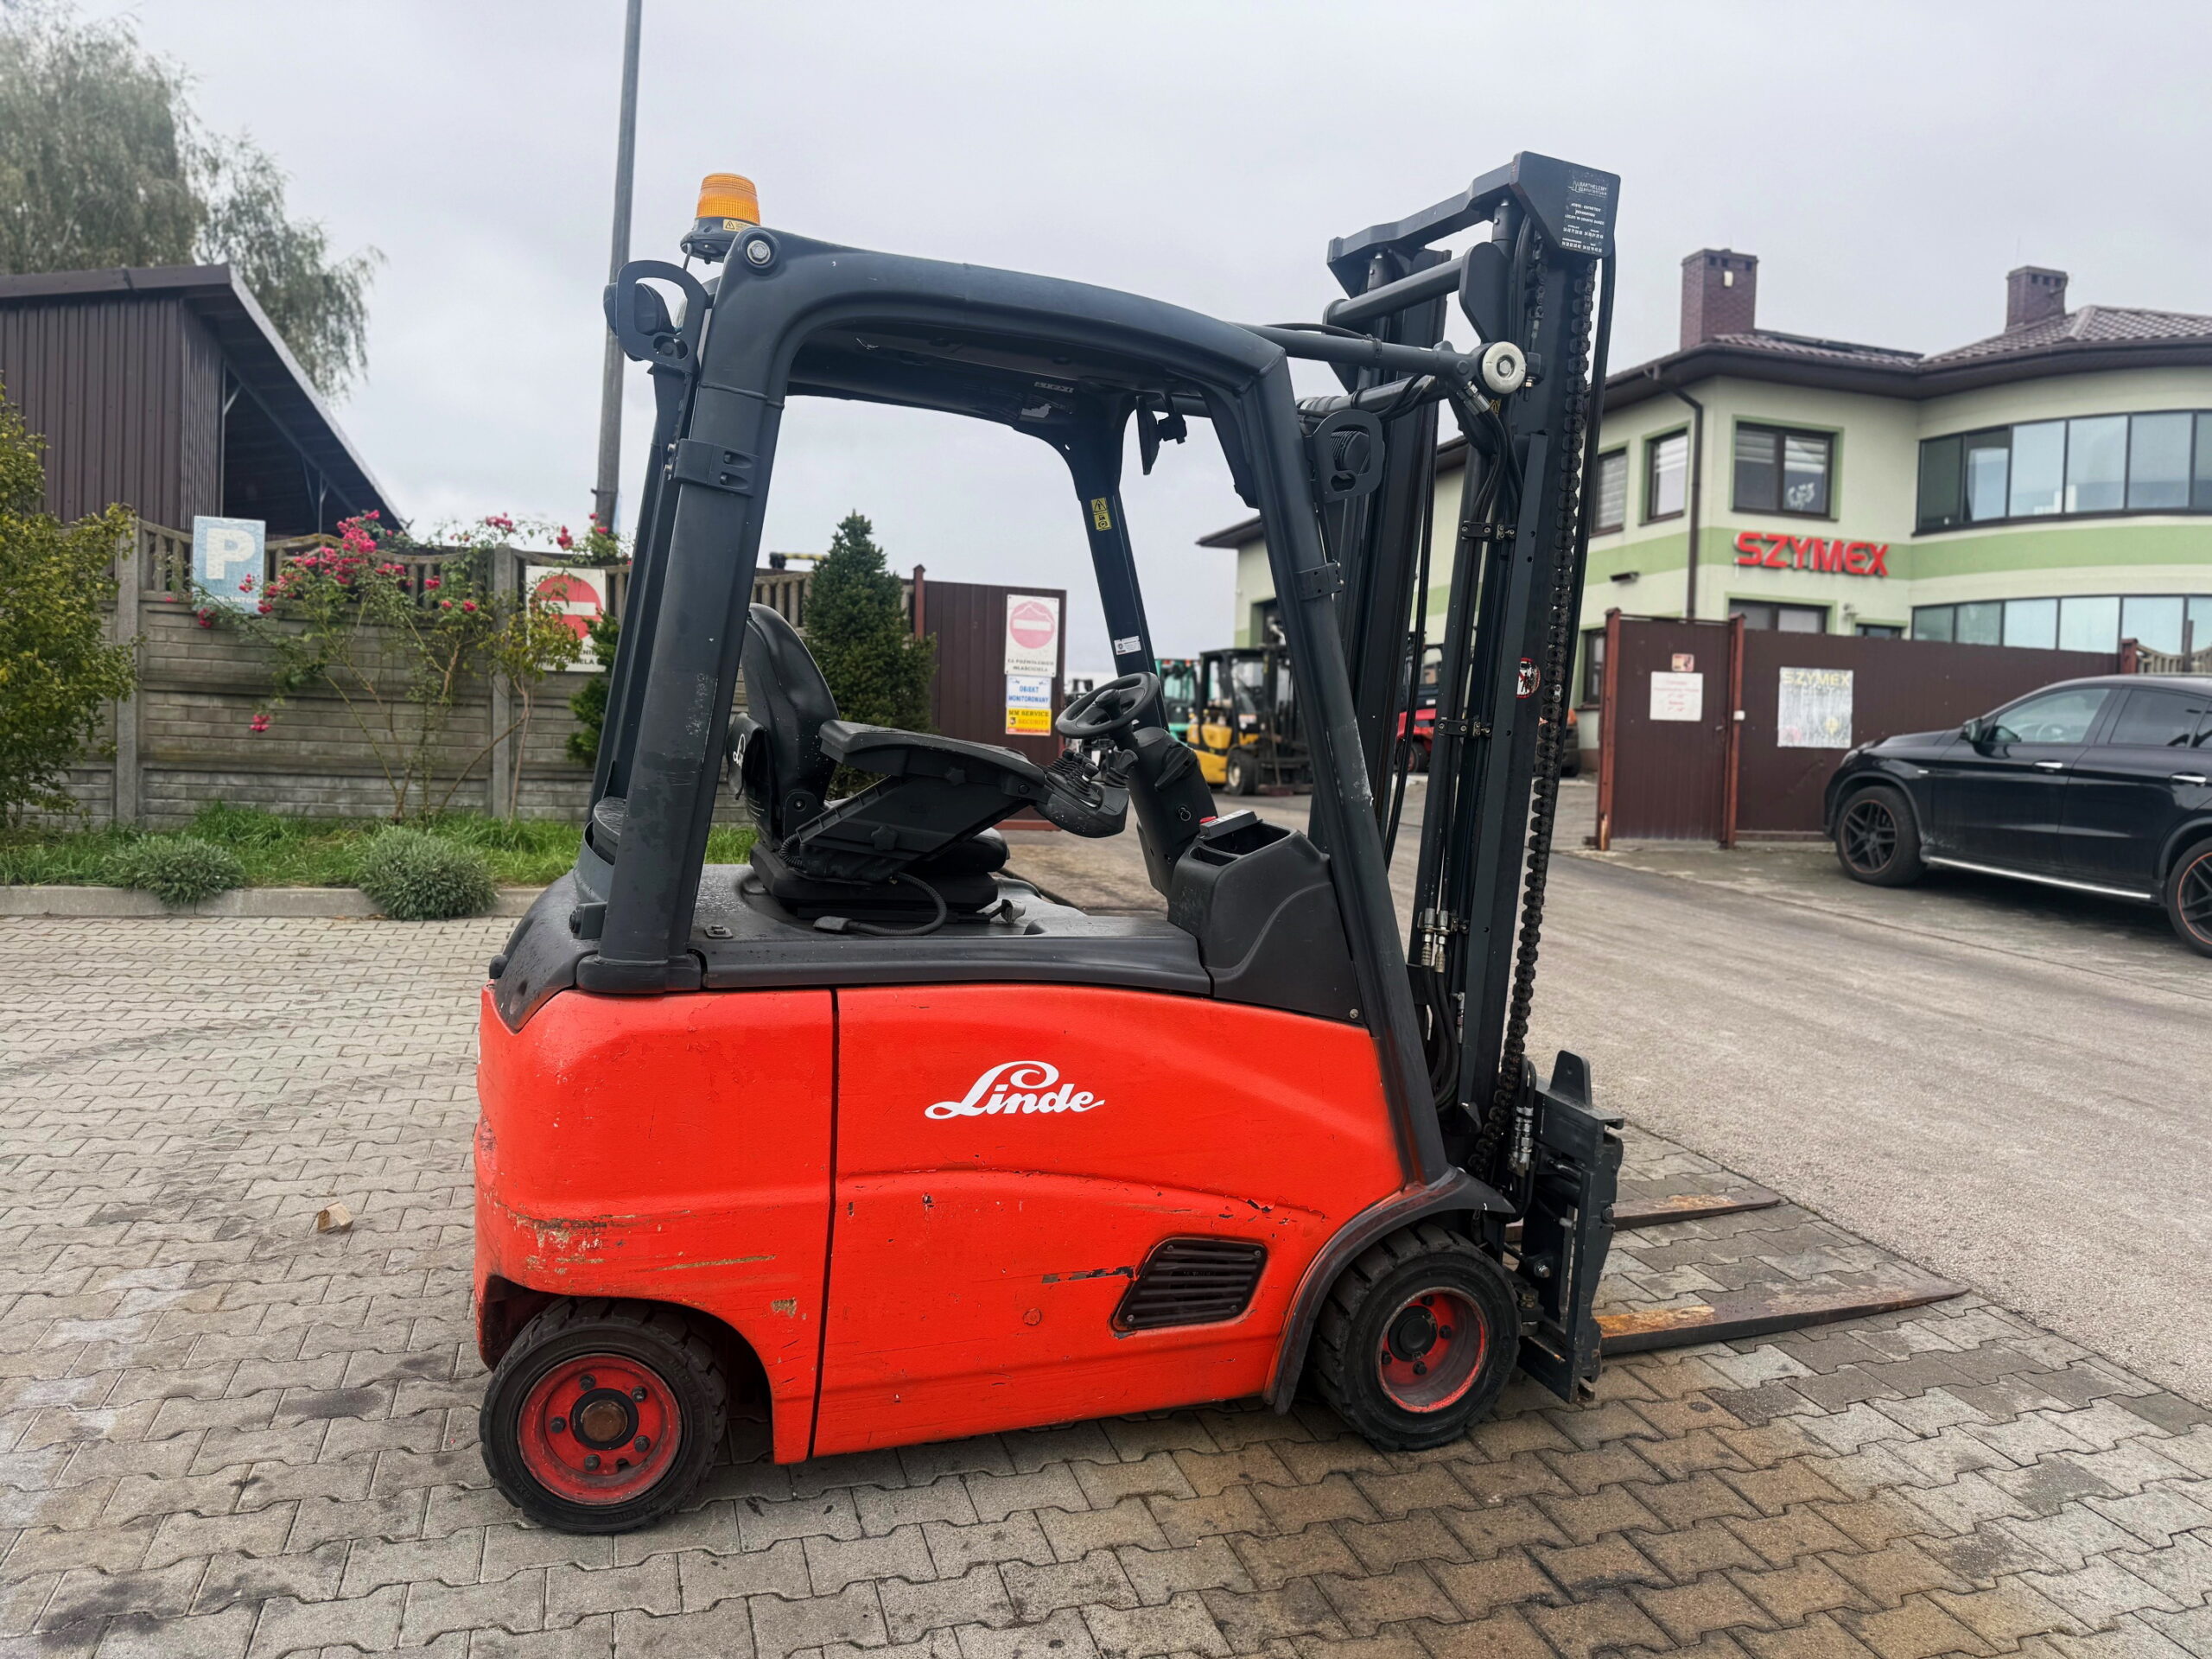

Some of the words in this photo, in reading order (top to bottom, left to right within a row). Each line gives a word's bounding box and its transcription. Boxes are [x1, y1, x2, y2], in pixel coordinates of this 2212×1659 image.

[206, 527, 256, 580] P
[1734, 531, 1889, 576] SZYMEX
[1008, 695, 1049, 703] MONITOROWANY
[1782, 671, 1850, 687] SZYMEX
[924, 1060, 1106, 1120] Linde
